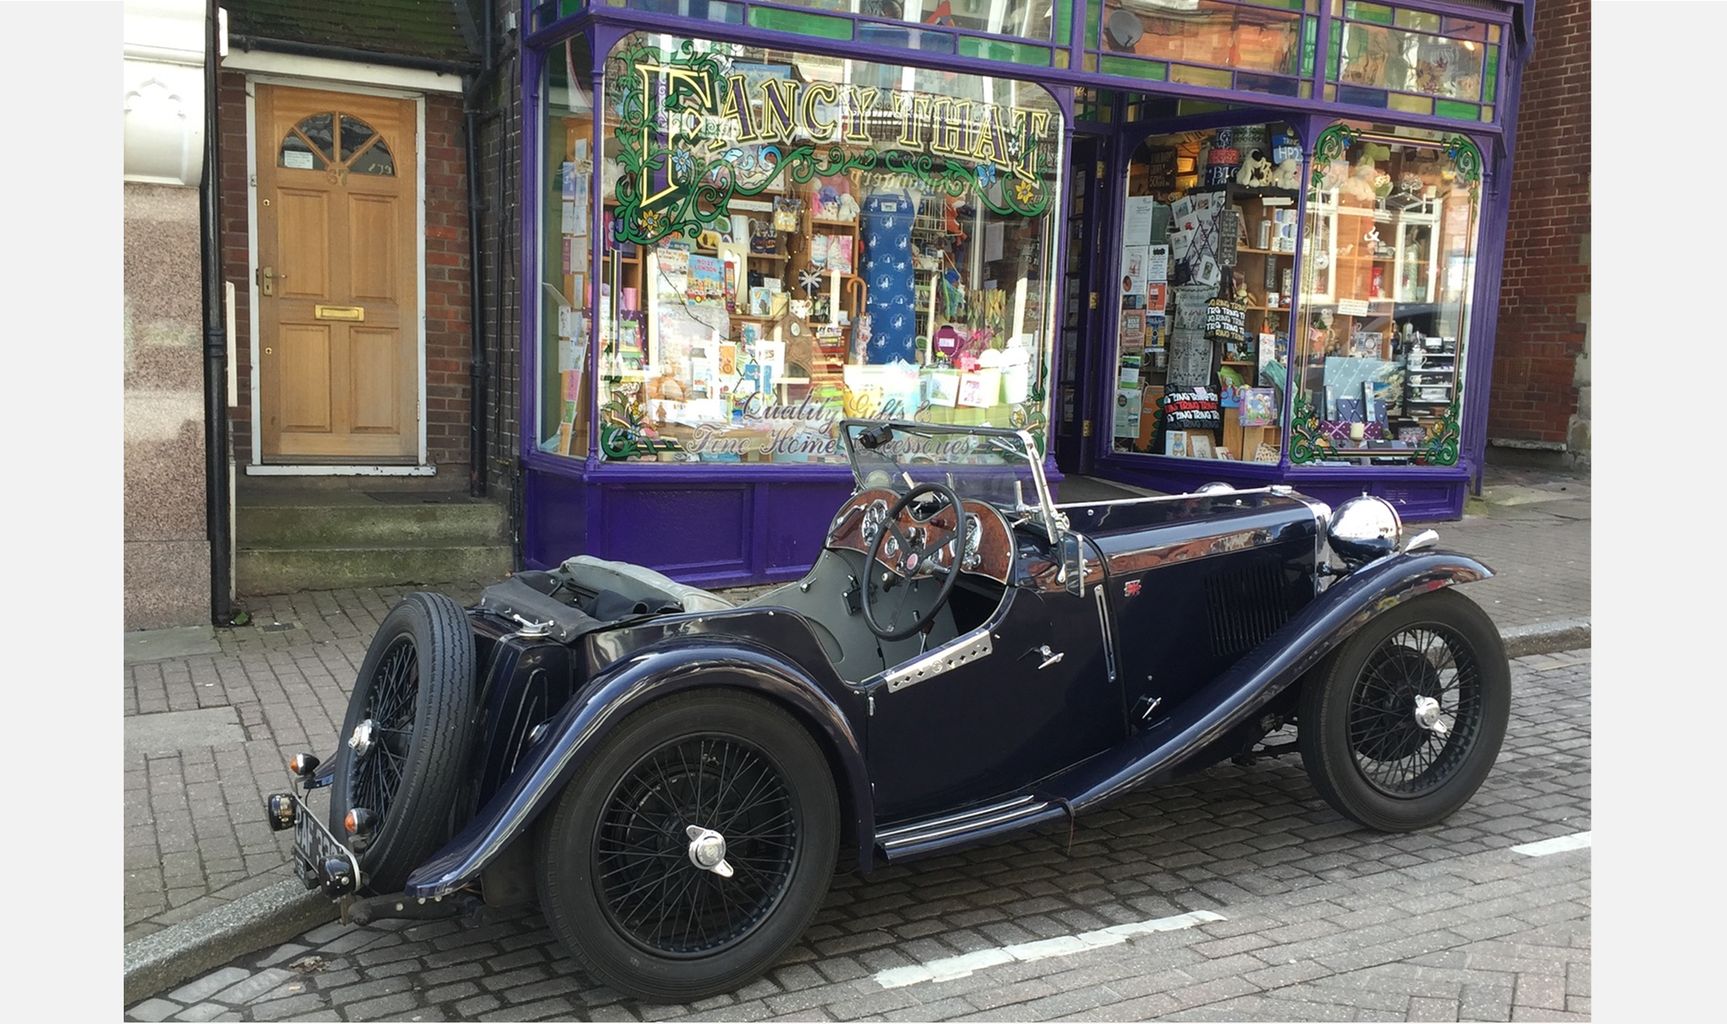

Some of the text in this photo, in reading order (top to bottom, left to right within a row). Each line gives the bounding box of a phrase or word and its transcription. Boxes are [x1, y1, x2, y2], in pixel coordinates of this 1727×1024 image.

[635, 64, 1051, 210] FANCY THAT
[742, 386, 838, 434] Quality
[849, 393, 906, 421] Gifts
[686, 423, 972, 456] Fine Home cessories
